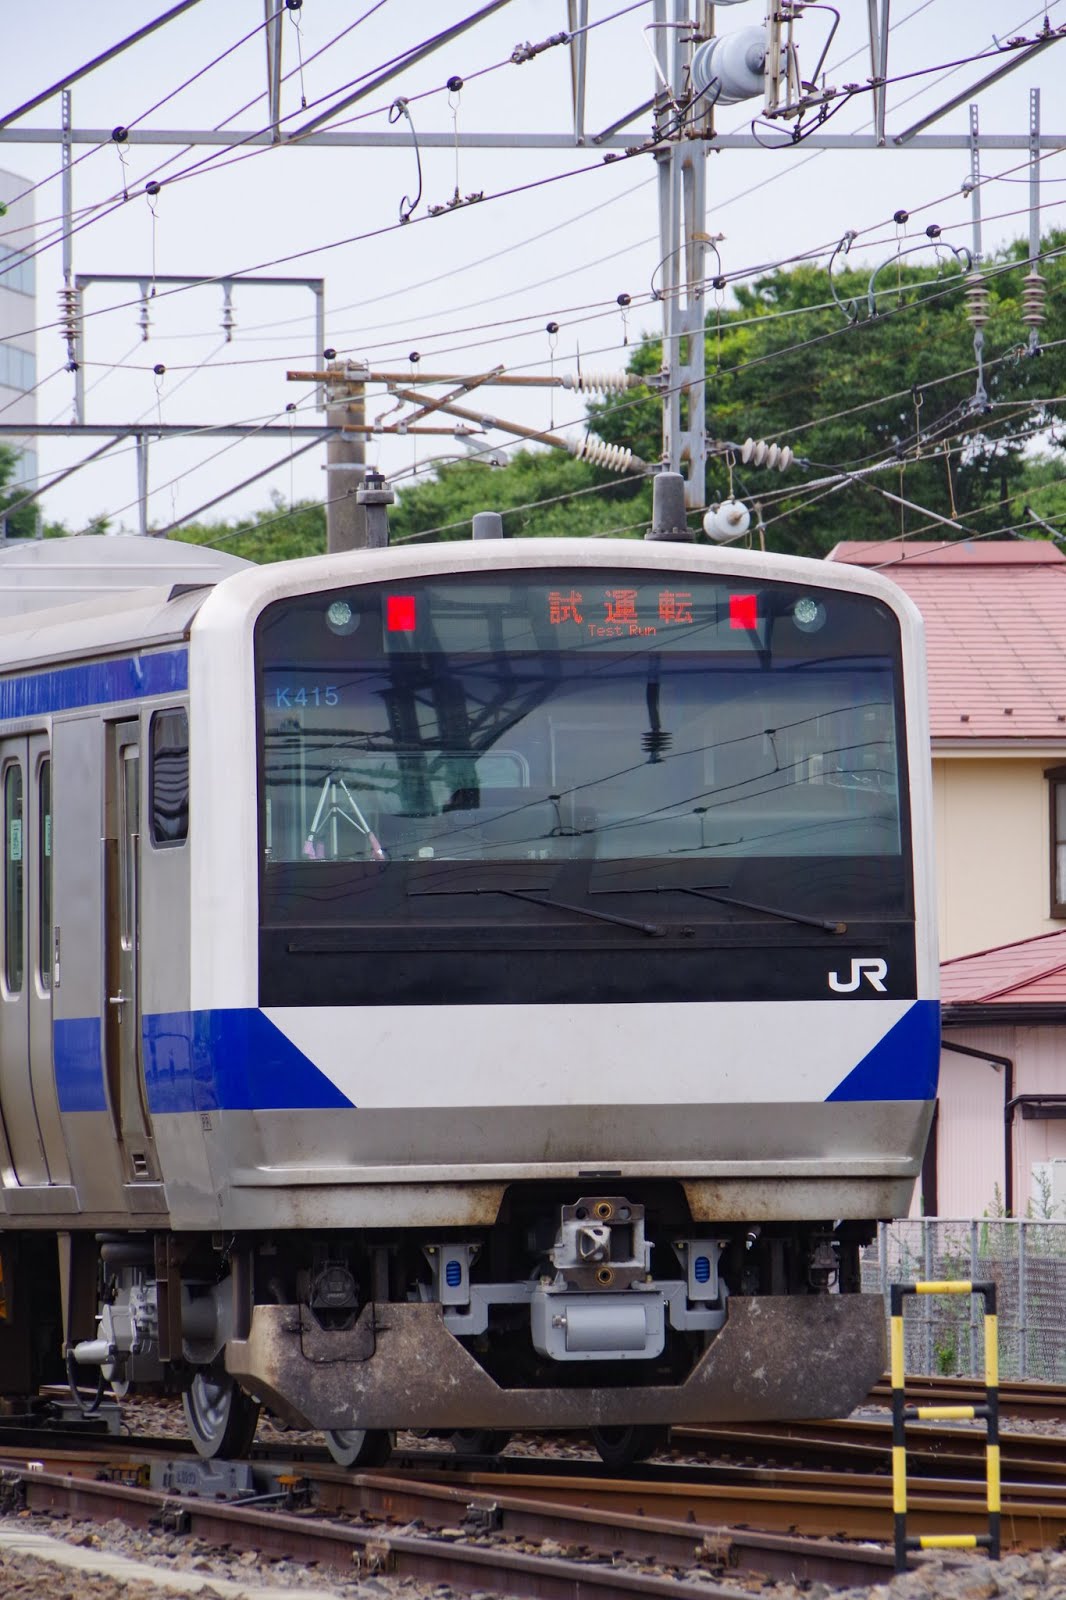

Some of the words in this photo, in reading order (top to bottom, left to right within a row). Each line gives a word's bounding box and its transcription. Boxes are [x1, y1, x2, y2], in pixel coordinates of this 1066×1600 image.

[549, 589, 693, 624] 試運転
[588, 624, 624, 637] Test
[629, 624, 656, 636] Run
[276, 686, 339, 707] K415
[828, 958, 888, 993] JR
